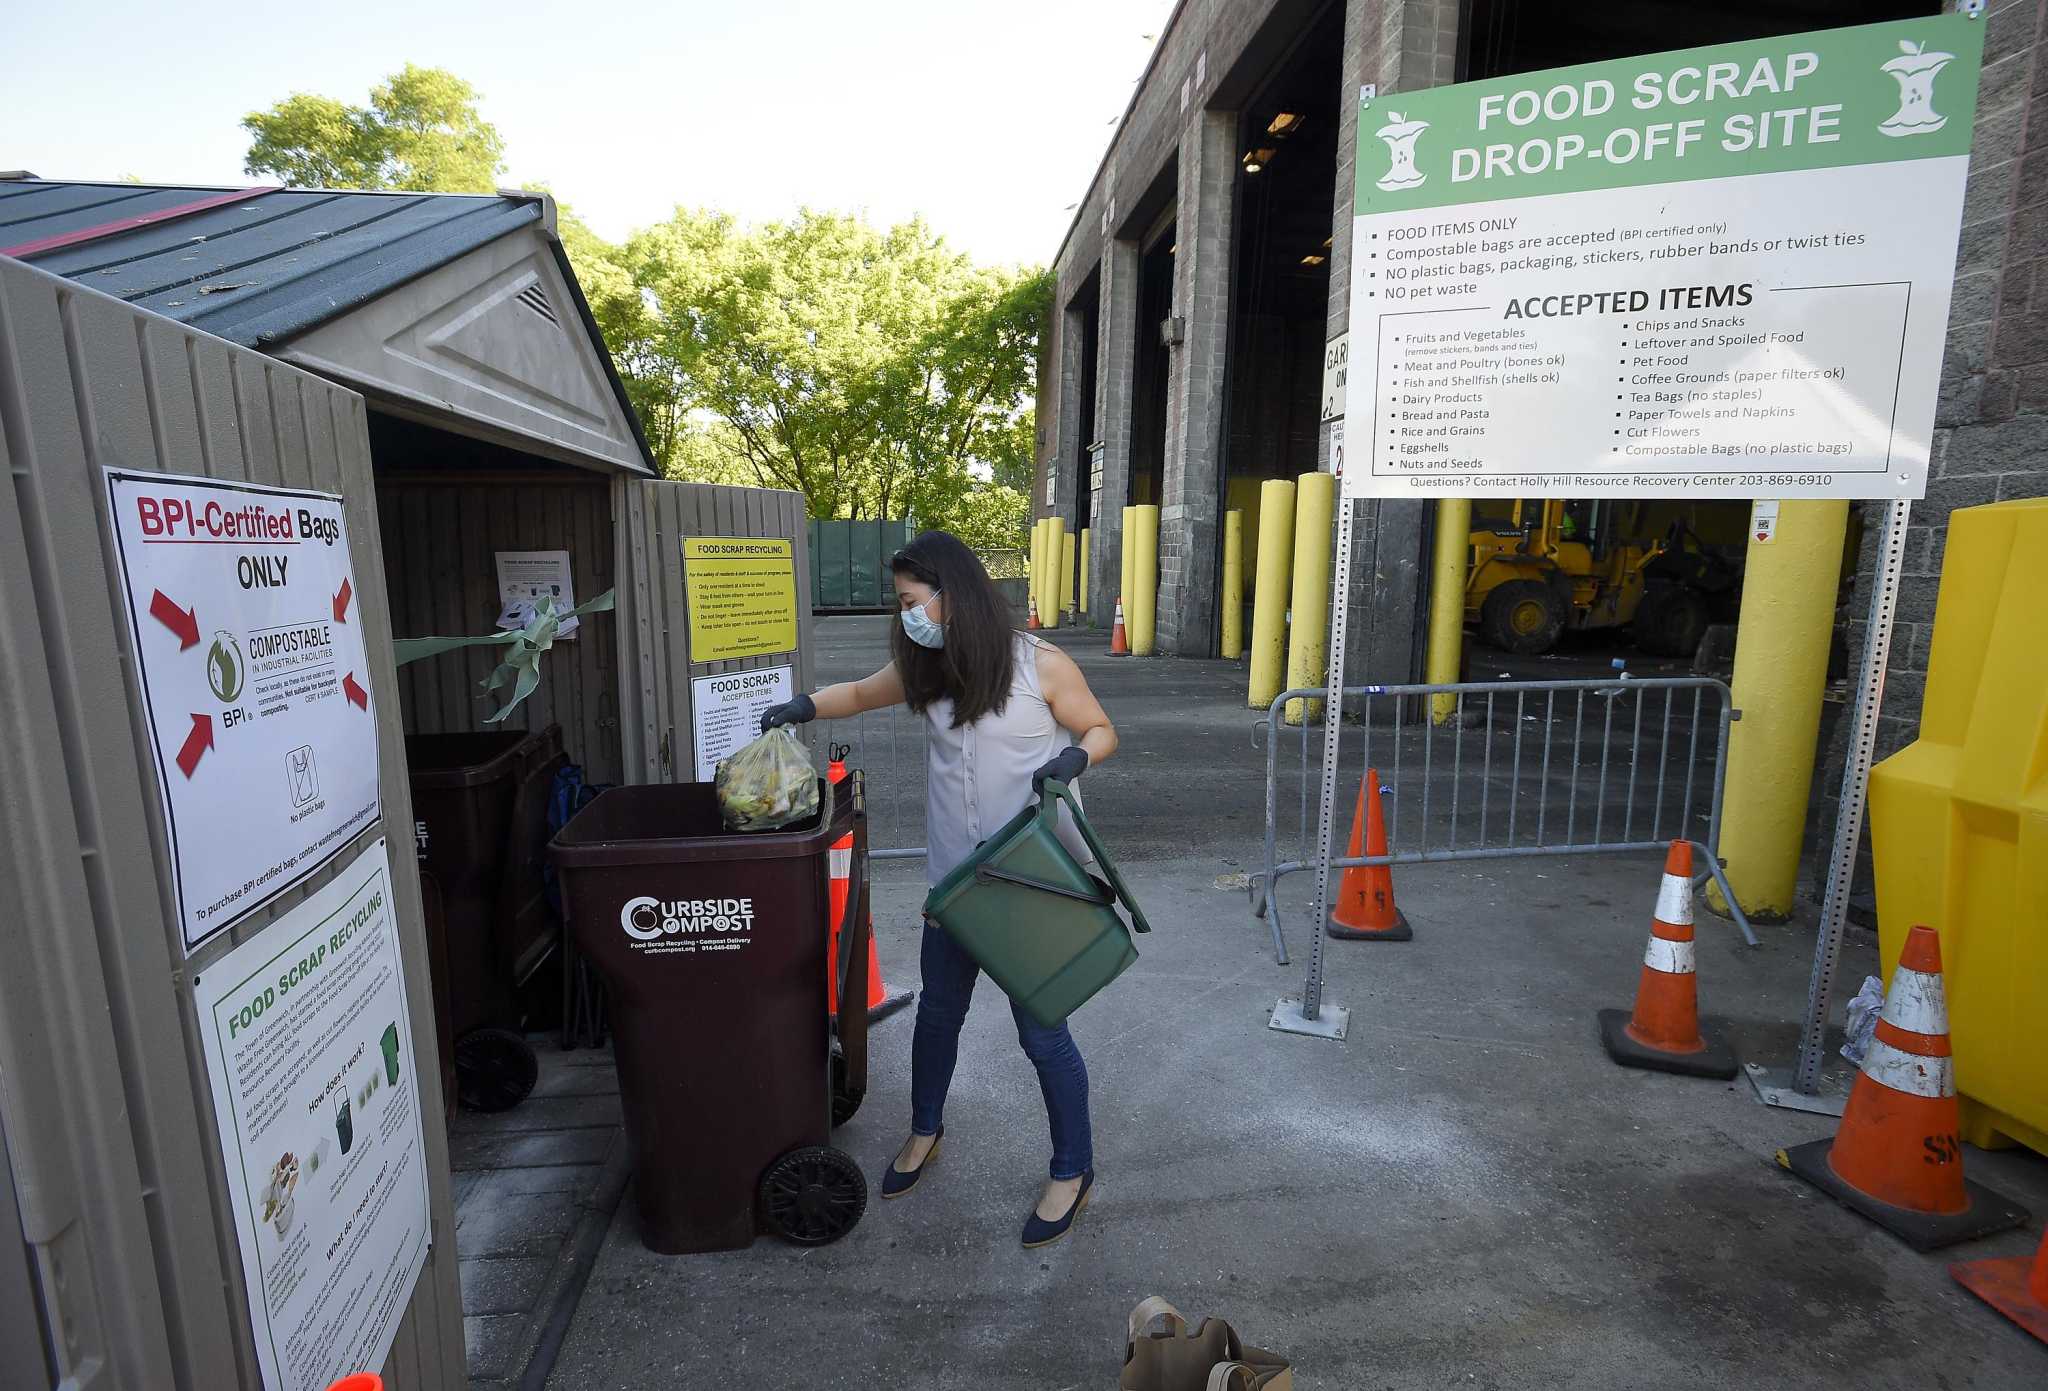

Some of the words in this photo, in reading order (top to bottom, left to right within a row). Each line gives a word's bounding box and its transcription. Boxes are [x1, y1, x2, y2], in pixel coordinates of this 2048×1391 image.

[1478, 79, 1615, 131] FOOD
[1631, 52, 1820, 110] SCRAP
[1450, 119, 1704, 184] DROP-OFF
[1721, 103, 1843, 153] SITE
[1388, 226, 1426, 240] FOOD
[1431, 221, 1474, 236] ITEMS
[1479, 216, 1517, 232] ONLY
[1386, 241, 1476, 260] Compostable
[1481, 239, 1513, 253] bags
[1518, 238, 1542, 248] are
[1546, 227, 1615, 246] accepted
[1620, 229, 1642, 242] (BPI
[1645, 224, 1694, 238] certified
[1697, 221, 1726, 234] only)
[1386, 267, 1406, 280] NO
[1411, 263, 1454, 280] plastic
[1459, 261, 1495, 275] bags,
[1500, 254, 1577, 273] packaging,
[1582, 249, 1643, 264] stickers,
[1649, 244, 1704, 259] rubber
[1709, 238, 1758, 254] bands
[1763, 239, 1782, 251] or
[1786, 234, 1829, 249] twist
[1834, 232, 1864, 245] ties
[1385, 286, 1405, 299] NO
[1410, 285, 1432, 300] pet
[1436, 282, 1476, 295] waste
[1503, 290, 1648, 319] ACCEPTED
[1659, 283, 1752, 310] ITEMS
[1636, 320, 1669, 332] Chips
[1673, 317, 1698, 329] and
[1701, 315, 1744, 328] Snacks
[1406, 333, 1436, 343] Fruits
[1439, 331, 1460, 342] and
[1463, 327, 1525, 342] Vegetables
[1634, 337, 1686, 349] Leftover
[1690, 335, 1714, 346] and
[1718, 332, 1766, 348] Spoiled
[1770, 330, 1804, 343] Food
[1404, 347, 1437, 357] (remove
[1474, 343, 1499, 352] bands
[1500, 342, 1517, 351] and
[1518, 342, 1537, 352] ties)
[1404, 361, 1432, 371] Meat
[1436, 359, 1456, 370] and
[1460, 358, 1500, 369] Poultry
[1504, 356, 1543, 368] (bones
[1546, 354, 1564, 366] ok)
[1633, 356, 1653, 367] Pet
[1657, 354, 1688, 367] Food
[1403, 377, 1424, 387] Fish
[1427, 376, 1448, 387] and
[1451, 374, 1498, 386] Shellfish
[1501, 372, 1538, 386] (shells
[1540, 371, 1559, 384] ok)
[1631, 373, 1671, 384] Coffee
[1675, 371, 1729, 383] Grounds
[1734, 369, 1777, 383] (paper
[1782, 368, 1820, 379] filters
[1823, 367, 1844, 380] ok)
[1402, 394, 1431, 406] Dairy
[1434, 392, 1482, 403] Products
[1629, 392, 1650, 402] Tea
[1654, 391, 1683, 403] Bags
[1687, 390, 1708, 402] (no
[1712, 387, 1762, 402] staples)
[1402, 410, 1433, 420] Bread
[1436, 409, 1456, 419] and
[1460, 409, 1489, 419] Pasta
[1628, 410, 1664, 422] Paper
[1667, 407, 1710, 418] Towels
[1714, 407, 1738, 418] and
[1742, 406, 1795, 420] Napkins
[1401, 427, 1423, 436] Rice
[1426, 425, 1446, 436] and
[1449, 425, 1484, 435] Grains
[1627, 427, 1648, 437] Cut
[1652, 424, 1700, 439] Flowers
[1400, 442, 1448, 454] Eggshells
[1625, 443, 1707, 456] Compostable
[1711, 443, 1743, 456] Bags
[1745, 441, 1769, 456] (no
[1770, 442, 1812, 456] plastic
[1817, 441, 1852, 456] bags)
[1399, 459, 1424, 469] Nuts
[1426, 457, 1449, 468] and
[1450, 457, 1482, 468] Seeds
[1410, 476, 1470, 487] Questions?
[1473, 476, 1516, 486] Contact
[1520, 476, 1549, 488] Holly
[1552, 476, 1571, 486] Hill
[1574, 476, 1629, 487] Resource
[1633, 476, 1689, 487] Recovery
[1692, 475, 1736, 485] Center
[1739, 475, 1832, 485] 203-869-6910
[137, 496, 294, 538] BPI-Certified
[299, 509, 340, 546] Bags
[698, 545, 720, 553] FOOD
[721, 545, 744, 554] SCRAP
[746, 545, 782, 554] RECYCLING
[236, 554, 289, 590] ONLY
[250, 626, 331, 659] COMPOSTABLE
[252, 666, 260, 674] IN
[260, 656, 300, 672] INDUSTRIAL
[301, 648, 333, 662] FACILITIES
[711, 679, 740, 694] FOOD
[743, 673, 780, 689] SCRAPS
[722, 690, 754, 702] ACCEPTED
[755, 688, 772, 697] ITEMS
[222, 707, 246, 729] BPI
[290, 814, 298, 824] No
[299, 806, 314, 820] plastic
[314, 800, 326, 813] bags
[196, 910, 207, 921] To
[208, 888, 242, 918] purchase
[243, 882, 255, 894] BPI
[256, 863, 283, 886] certified
[283, 856, 298, 872] bags,
[298, 844, 318, 861] contact
[228, 986, 275, 1040] FOOD
[278, 945, 326, 996] SCRAP
[329, 891, 382, 954] RECYCLING
[308, 1091, 324, 1115] How
[326, 1072, 341, 1095] does
[342, 1064, 347, 1076] it
[347, 1041, 365, 1069] work?
[326, 1232, 344, 1261] What
[344, 1220, 352, 1235] do
[356, 1189, 369, 1218] need
[369, 1184, 375, 1196] to
[376, 1160, 388, 1187] start?
